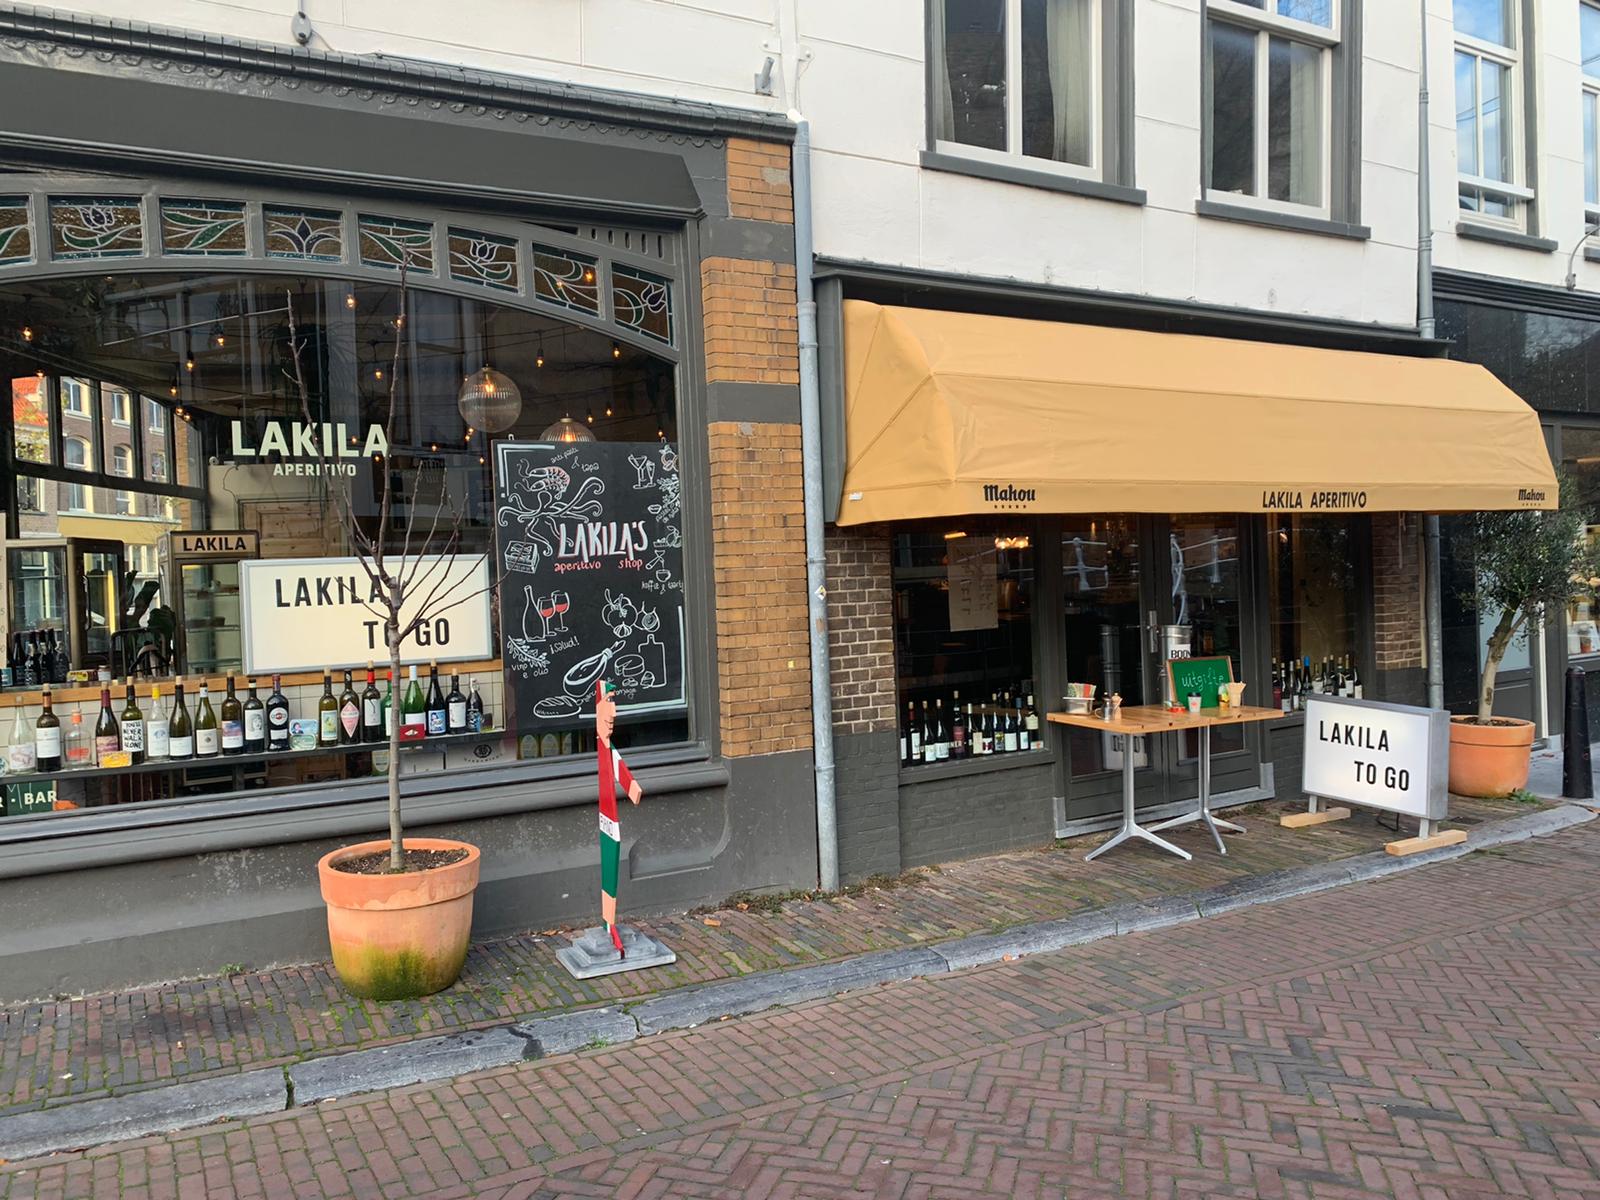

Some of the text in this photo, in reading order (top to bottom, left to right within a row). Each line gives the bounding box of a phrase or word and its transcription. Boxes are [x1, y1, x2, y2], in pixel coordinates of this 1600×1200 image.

[231, 420, 391, 458] LAKILA
[273, 463, 357, 476] APERITIVO
[983, 484, 1036, 502] Mahou
[1262, 491, 1367, 508] LAKILA APERITIVO
[1518, 488, 1546, 501] Mahou
[182, 536, 247, 552] LAKILA
[558, 520, 649, 563] LAKILA'S
[554, 558, 644, 574] aperitivo shop
[275, 574, 385, 608] LAKILA
[415, 617, 450, 646] GO
[1319, 720, 1390, 752] LAKILA
[1354, 760, 1410, 792] TO GO
[24, 790, 58, 805] BAR
